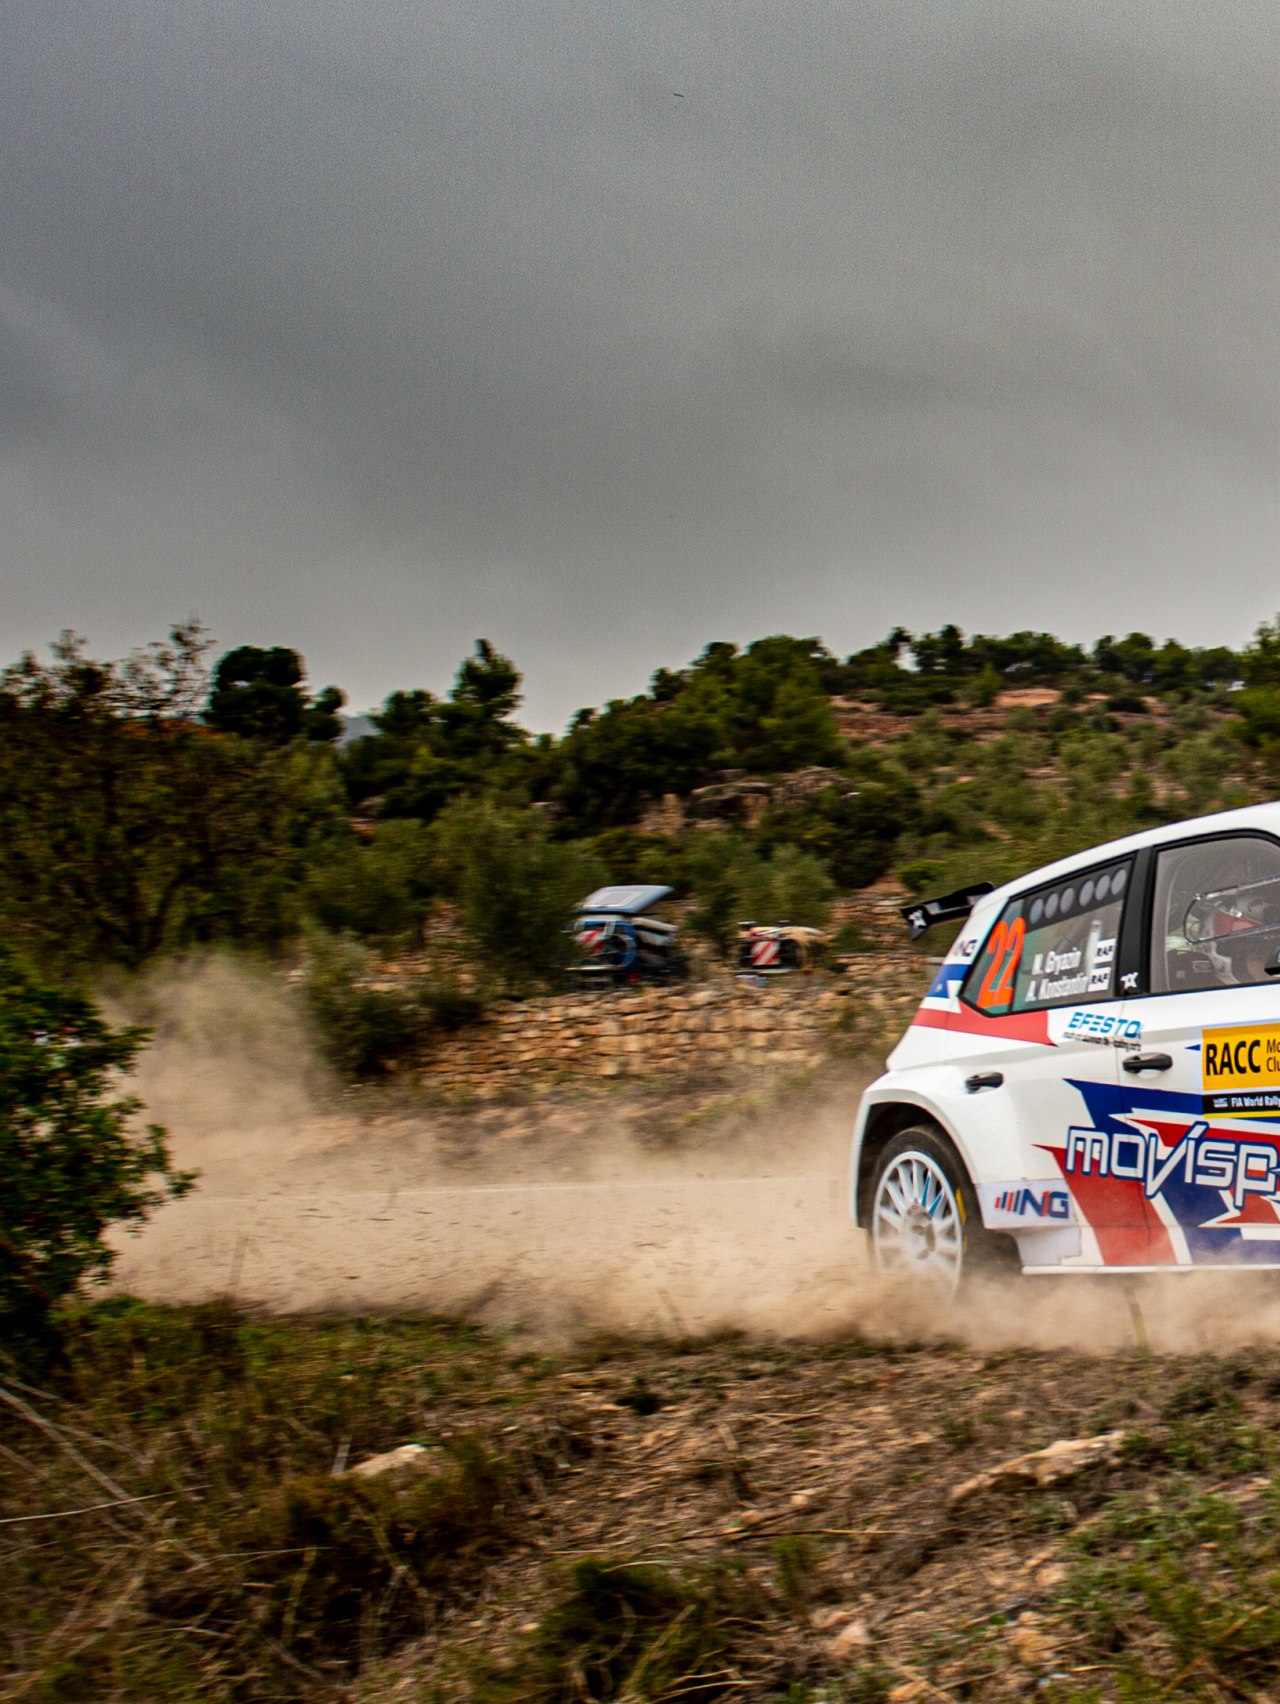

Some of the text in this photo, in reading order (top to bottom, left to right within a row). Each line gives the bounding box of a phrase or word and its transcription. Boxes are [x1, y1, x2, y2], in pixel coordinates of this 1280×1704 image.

[977, 917, 1026, 1008] 22
[1068, 1011, 1142, 1039] EFESTO
[1205, 1039, 1261, 1076] RACC
[1231, 1097, 1243, 1107] FIA
[1243, 1096, 1264, 1107] World
